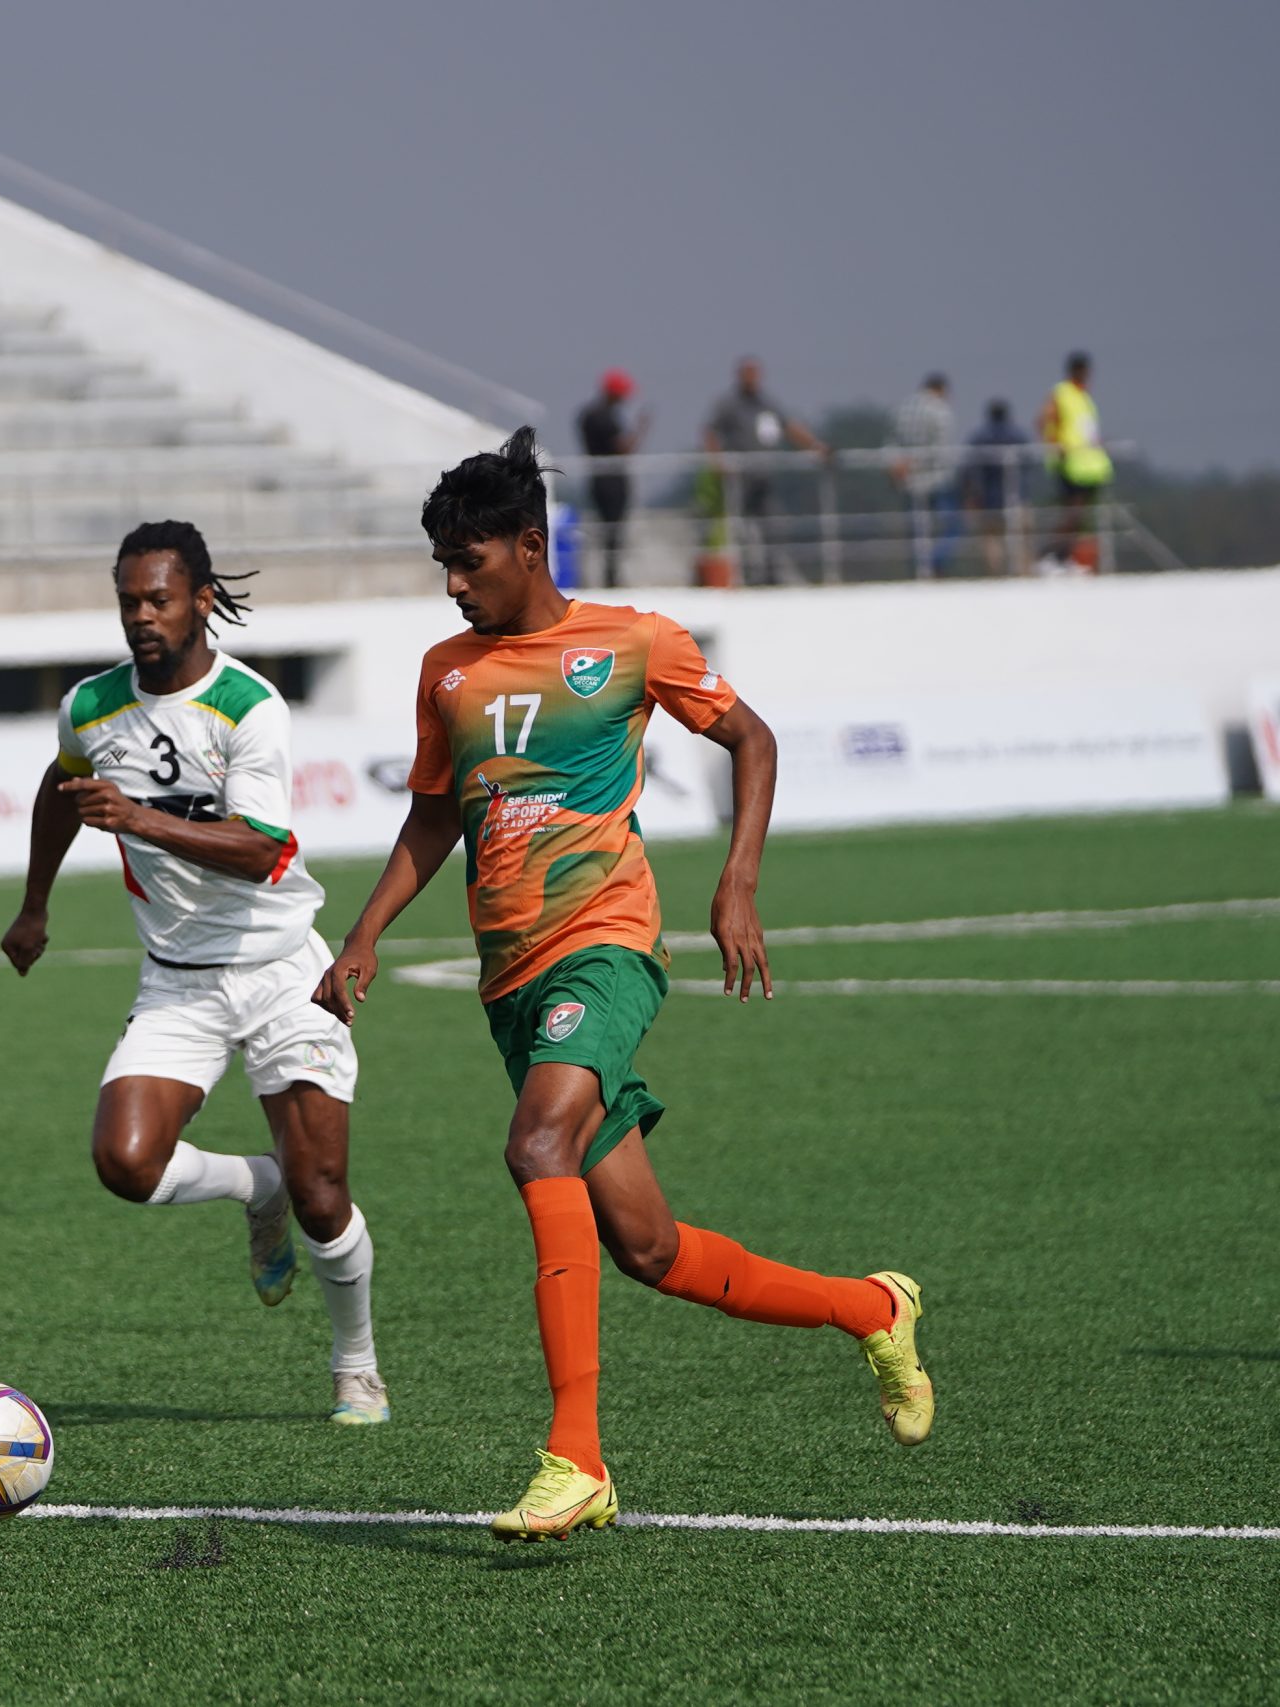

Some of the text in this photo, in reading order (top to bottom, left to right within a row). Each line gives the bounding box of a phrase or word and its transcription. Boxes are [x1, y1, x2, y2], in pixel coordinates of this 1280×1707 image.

[484, 693, 542, 755] 17
[149, 734, 180, 786] 3
[496, 815, 549, 831] ACADEMY
[501, 802, 559, 821] SPORTS
